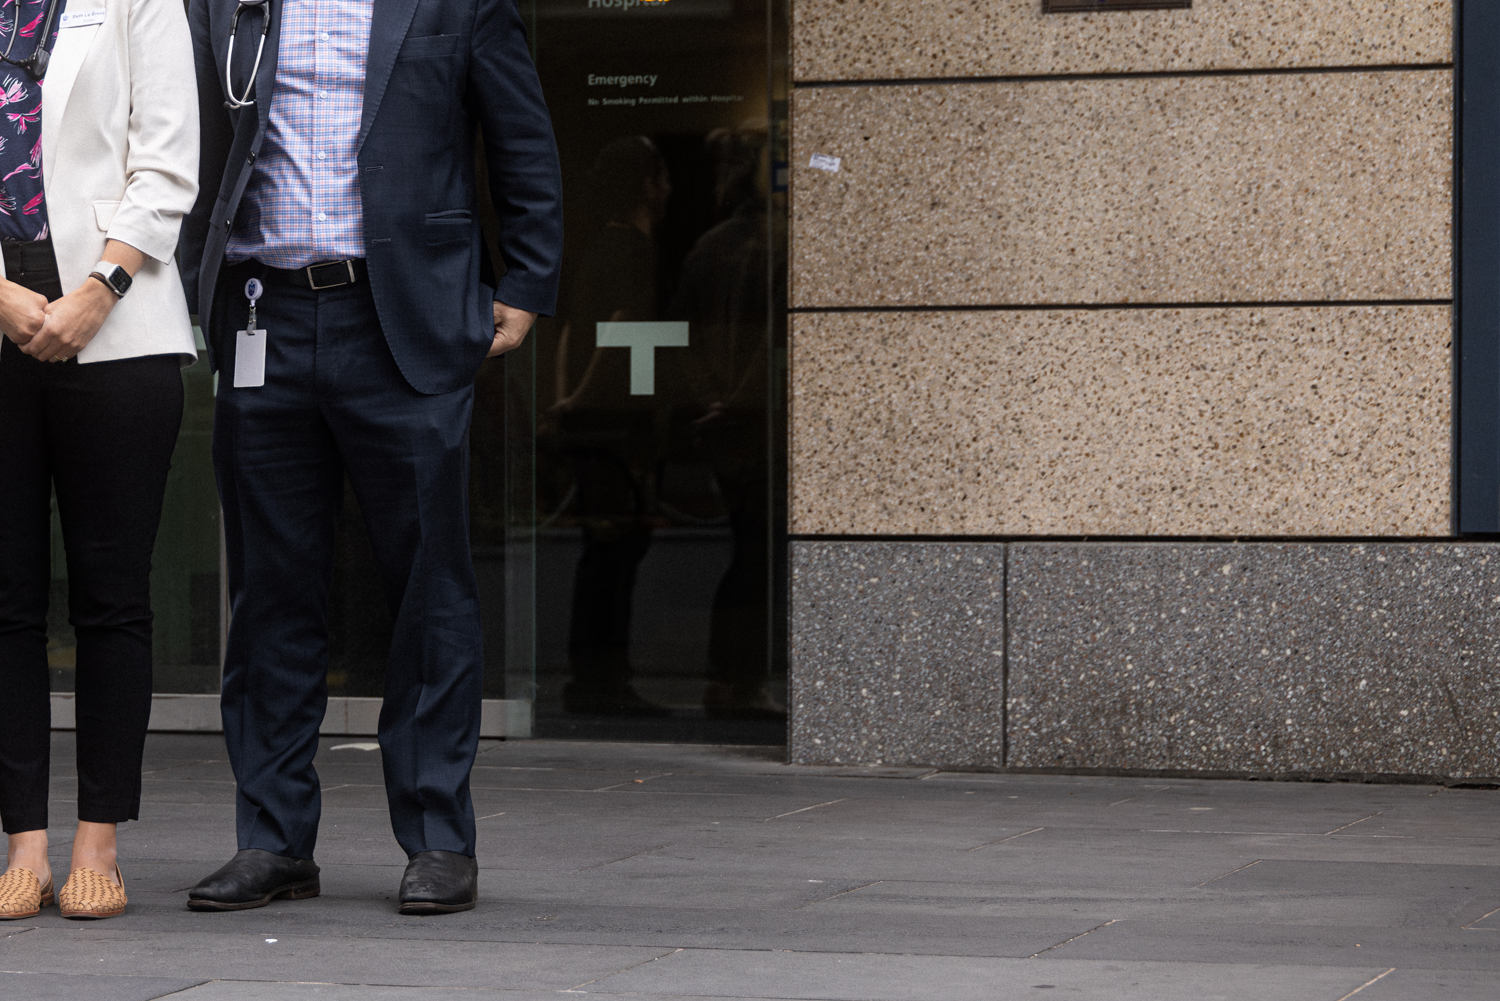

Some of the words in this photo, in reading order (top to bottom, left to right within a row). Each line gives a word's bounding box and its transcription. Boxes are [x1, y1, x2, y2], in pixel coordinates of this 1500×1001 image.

[587, 73, 658, 88] Emergency
[588, 98, 600, 106] No
[602, 96, 636, 107] Smoking
[638, 95, 679, 105] Permitted
[682, 94, 708, 103] within
